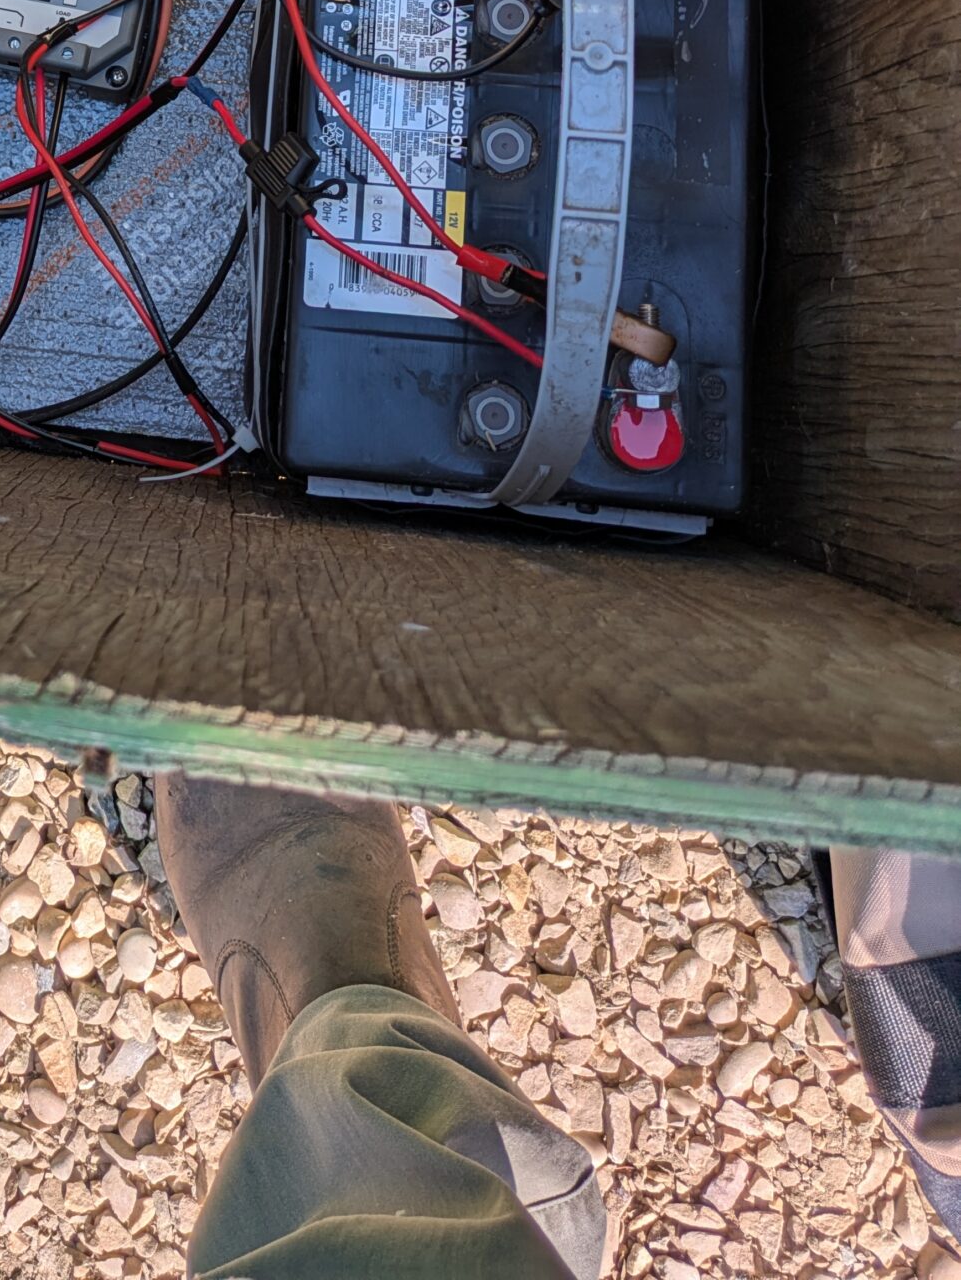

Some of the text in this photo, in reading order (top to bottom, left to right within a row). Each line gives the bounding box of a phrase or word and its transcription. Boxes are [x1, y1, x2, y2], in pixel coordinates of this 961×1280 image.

[450, 25, 468, 159] DANGR/POISON
[321, 201, 332, 223] 20Hr
[372, 212, 382, 233] CCA
[449, 212, 459, 228] 12V
